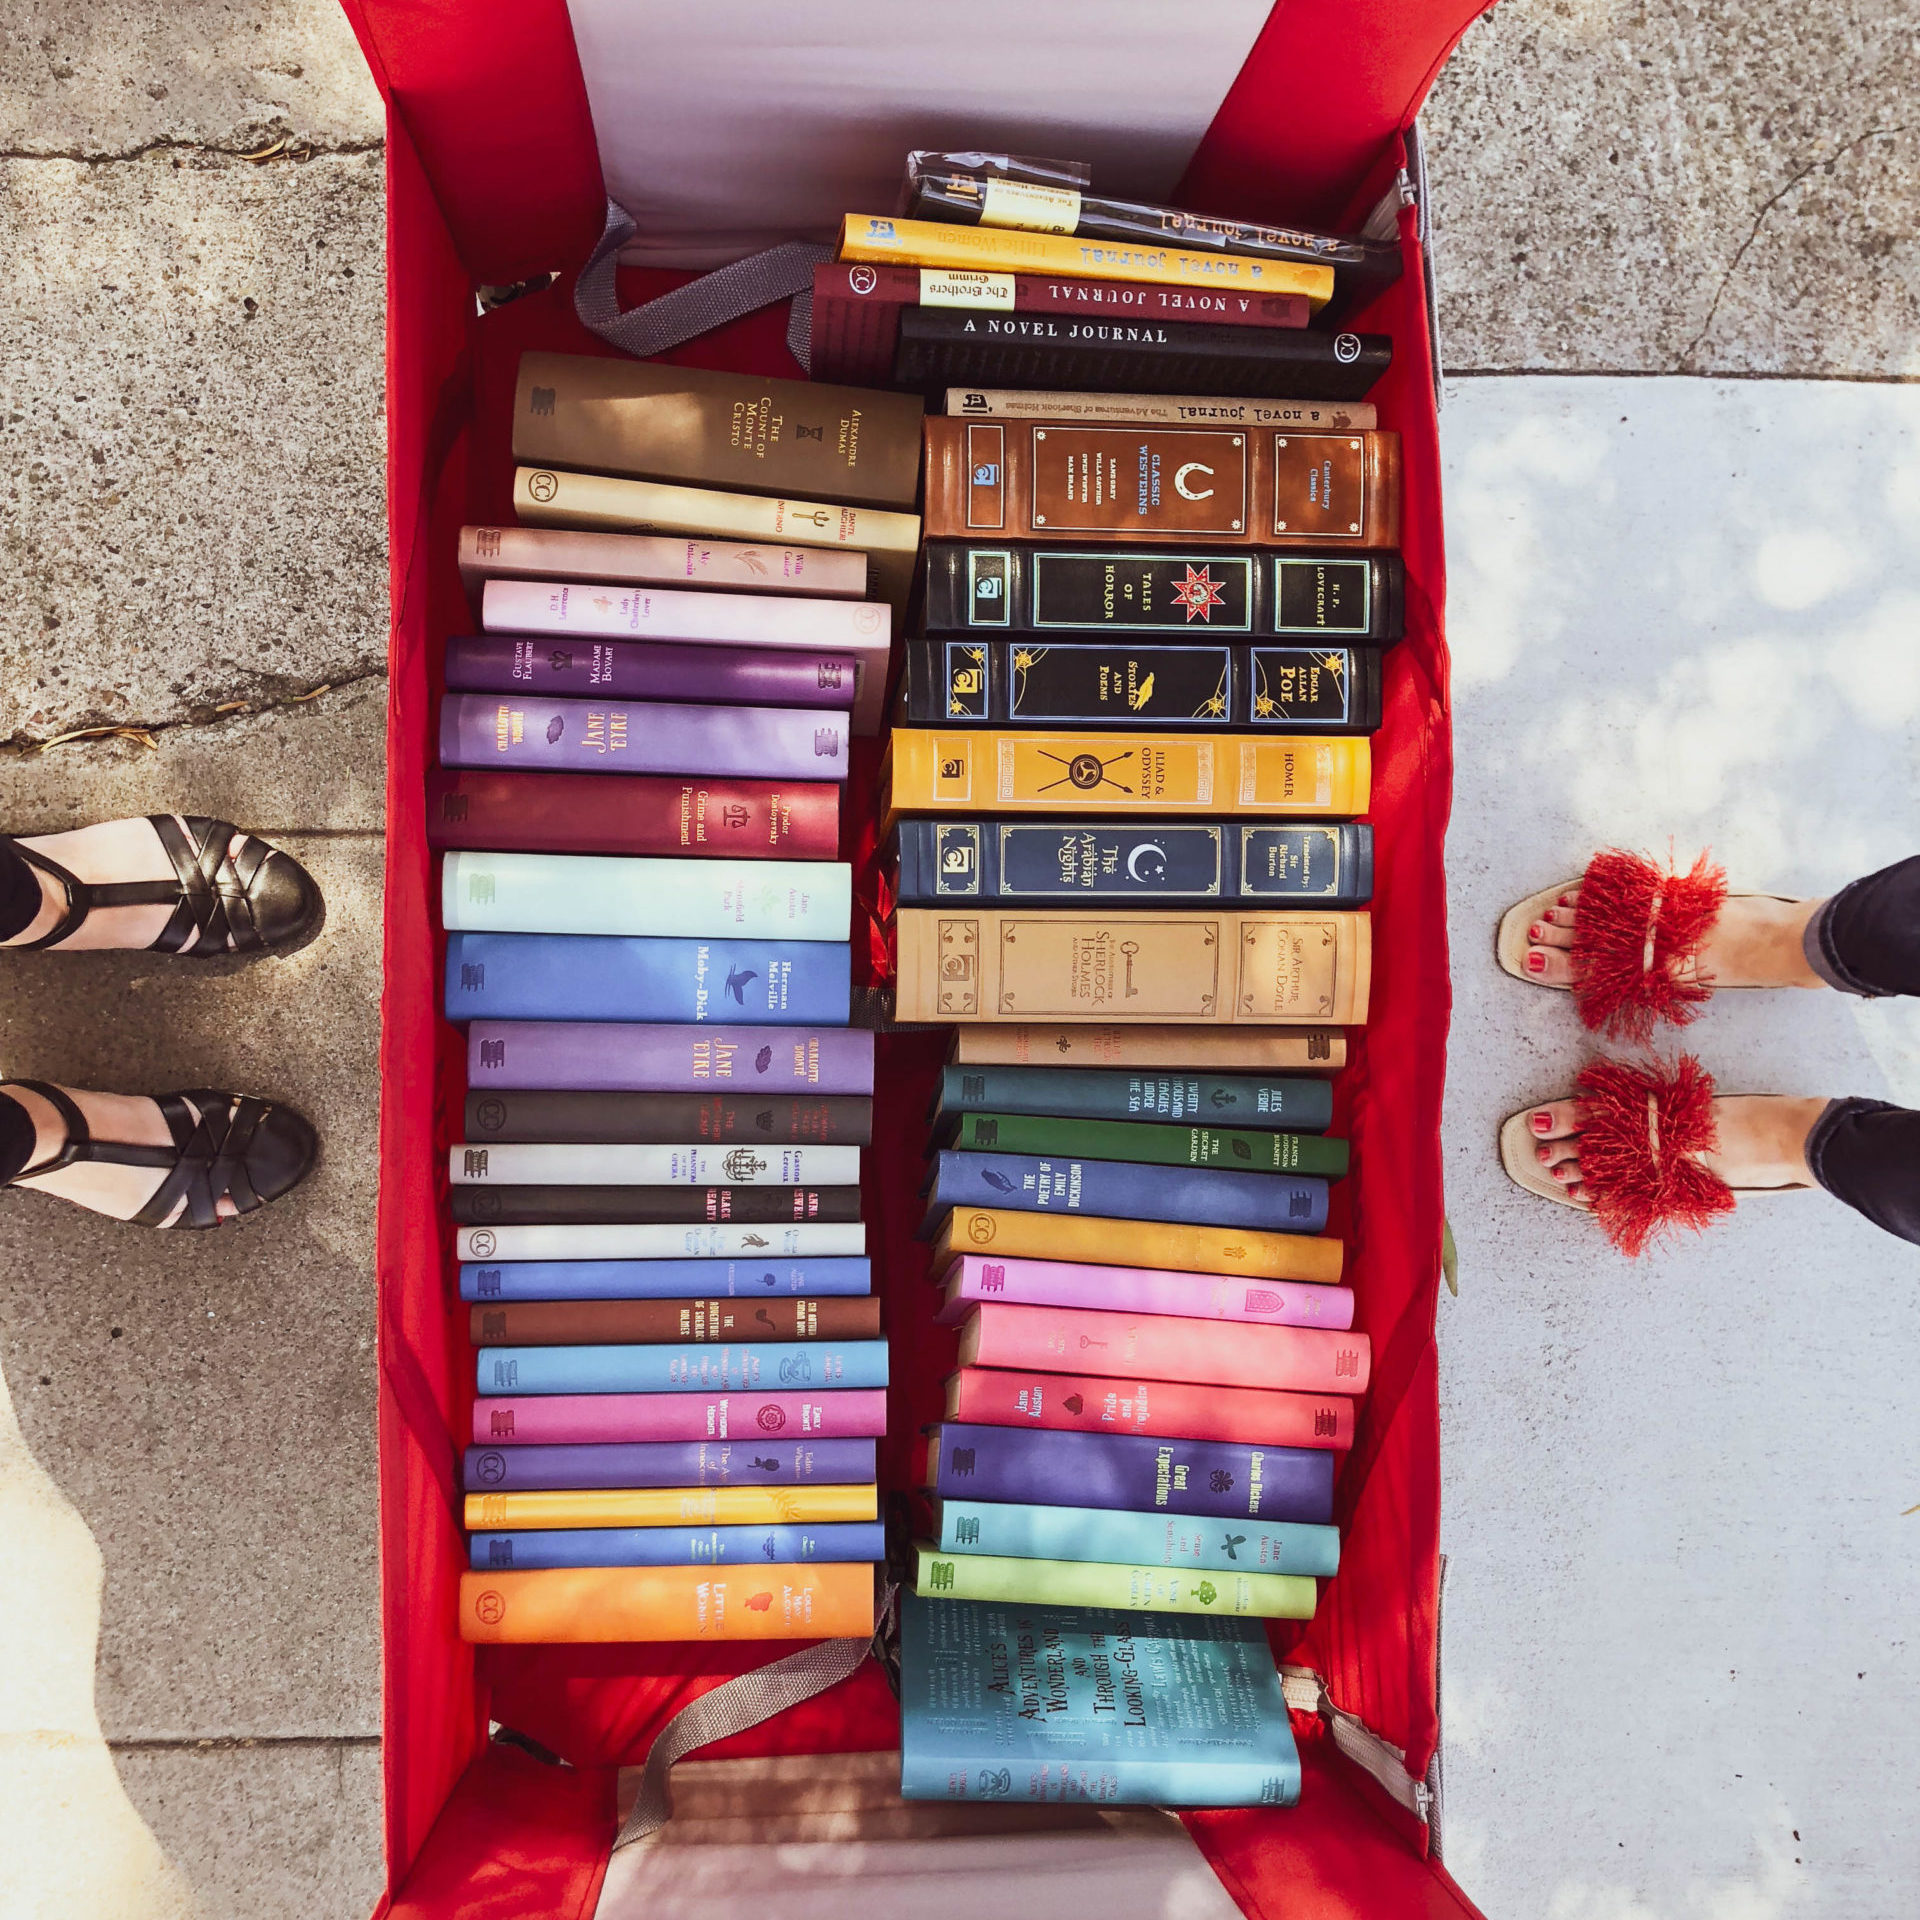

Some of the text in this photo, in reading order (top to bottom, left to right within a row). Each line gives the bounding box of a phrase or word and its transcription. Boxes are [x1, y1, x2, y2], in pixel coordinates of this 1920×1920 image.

[936, 230, 1047, 257] Little Women
[1160, 213, 1315, 248] novel journal
[949, 273, 990, 284] Grimm
[1080, 247, 1263, 279] a novel journal
[930, 283, 1009, 299] The Brothers
[1048, 284, 1250, 312] A NOVEL JOURNAL
[964, 319, 1169, 344] A NOVEL JOURNAL
[731, 402, 745, 447] CRISTO
[744, 403, 758, 450] MONTE
[756, 397, 771, 459] COUNT OF
[770, 416, 782, 442] THE
[1095, 405, 1148, 417] Adventures
[1177, 406, 1321, 423] a novel journal
[837, 419, 849, 456] DUMAS
[848, 409, 862, 468] ALEXANDRE
[1138, 444, 1149, 515] WESTERNS
[1151, 454, 1161, 506] CLASSIC
[1309, 467, 1319, 503] Classics
[1321, 459, 1333, 511] Canterbury
[847, 512, 857, 536] DANTE
[1104, 564, 1115, 620] HORROR
[1123, 582, 1133, 601] OF
[1142, 572, 1152, 612] TALES
[1316, 566, 1326, 626] LOVECRAFT
[512, 641, 524, 679] GUSTAVE
[590, 644, 602, 685] MADAME
[1100, 665, 1110, 702] POEMS
[1113, 671, 1123, 695] AND
[1127, 660, 1139, 707] STORIES
[1280, 665, 1296, 703] POE
[1298, 666, 1308, 702] ALLAN
[1310, 666, 1321, 704] EDGAR
[581, 712, 607, 755] JANE
[609, 711, 629, 752] EYRE
[1140, 746, 1151, 800] ODYSSEY
[1154, 750, 1165, 784] ILIAD
[1283, 752, 1294, 798] HOMER
[680, 786, 693, 847] Punishment
[696, 790, 709, 843] Crime and
[1057, 834, 1078, 884] Nights
[1079, 831, 1100, 889] Arabian
[1101, 844, 1120, 875] The
[1268, 845, 1278, 878] Burton
[1278, 843, 1289, 880] Richard
[1289, 853, 1298, 870] Sir
[694, 945, 710, 1022] Moby-Dick
[767, 960, 779, 1010] Melville
[780, 960, 792, 1010] Herman
[1079, 937, 1095, 998] HOLMES
[1091, 930, 1110, 1007] SHERLOCK
[692, 1038, 711, 1080] EYRE
[712, 1036, 739, 1079] JANE
[1128, 1095, 1140, 1112] SEA
[1270, 1089, 1283, 1113] JULES
[1189, 1128, 1199, 1162] GARDEN
[1200, 1130, 1209, 1161] SECRET
[1211, 1138, 1219, 1155] THE
[793, 1150, 803, 1182] Gaston
[1023, 1173, 1036, 1190] THE
[1037, 1161, 1052, 1205] POETRY OF
[1053, 1172, 1067, 1197] EMILY
[1067, 1163, 1082, 1208] DICKINSON
[720, 1190, 732, 1219] BLACK
[723, 1315, 734, 1328] THE
[1014, 1389, 1029, 1412] Jane
[1028, 1386, 1043, 1418] Austen
[1101, 1392, 1117, 1422] Pride
[1119, 1398, 1132, 1419] and
[720, 1444, 732, 1465] The
[1155, 1446, 1174, 1507] Expectations
[1173, 1464, 1190, 1491] Great
[1248, 1482, 1263, 1514] Dickens
[1259, 1535, 1270, 1565] Austen
[1272, 1539, 1283, 1561] Jane
[986, 1642, 1017, 1696] ALICE'S
[1017, 1634, 1048, 1723] ADVENTURES
[1041, 1627, 1070, 1714] WONDERLAND
[1072, 1657, 1091, 1678] AND
[1090, 1629, 1117, 1715] THROUGH THE
[1113, 1621, 1147, 1727] LOOKING-GLASS
